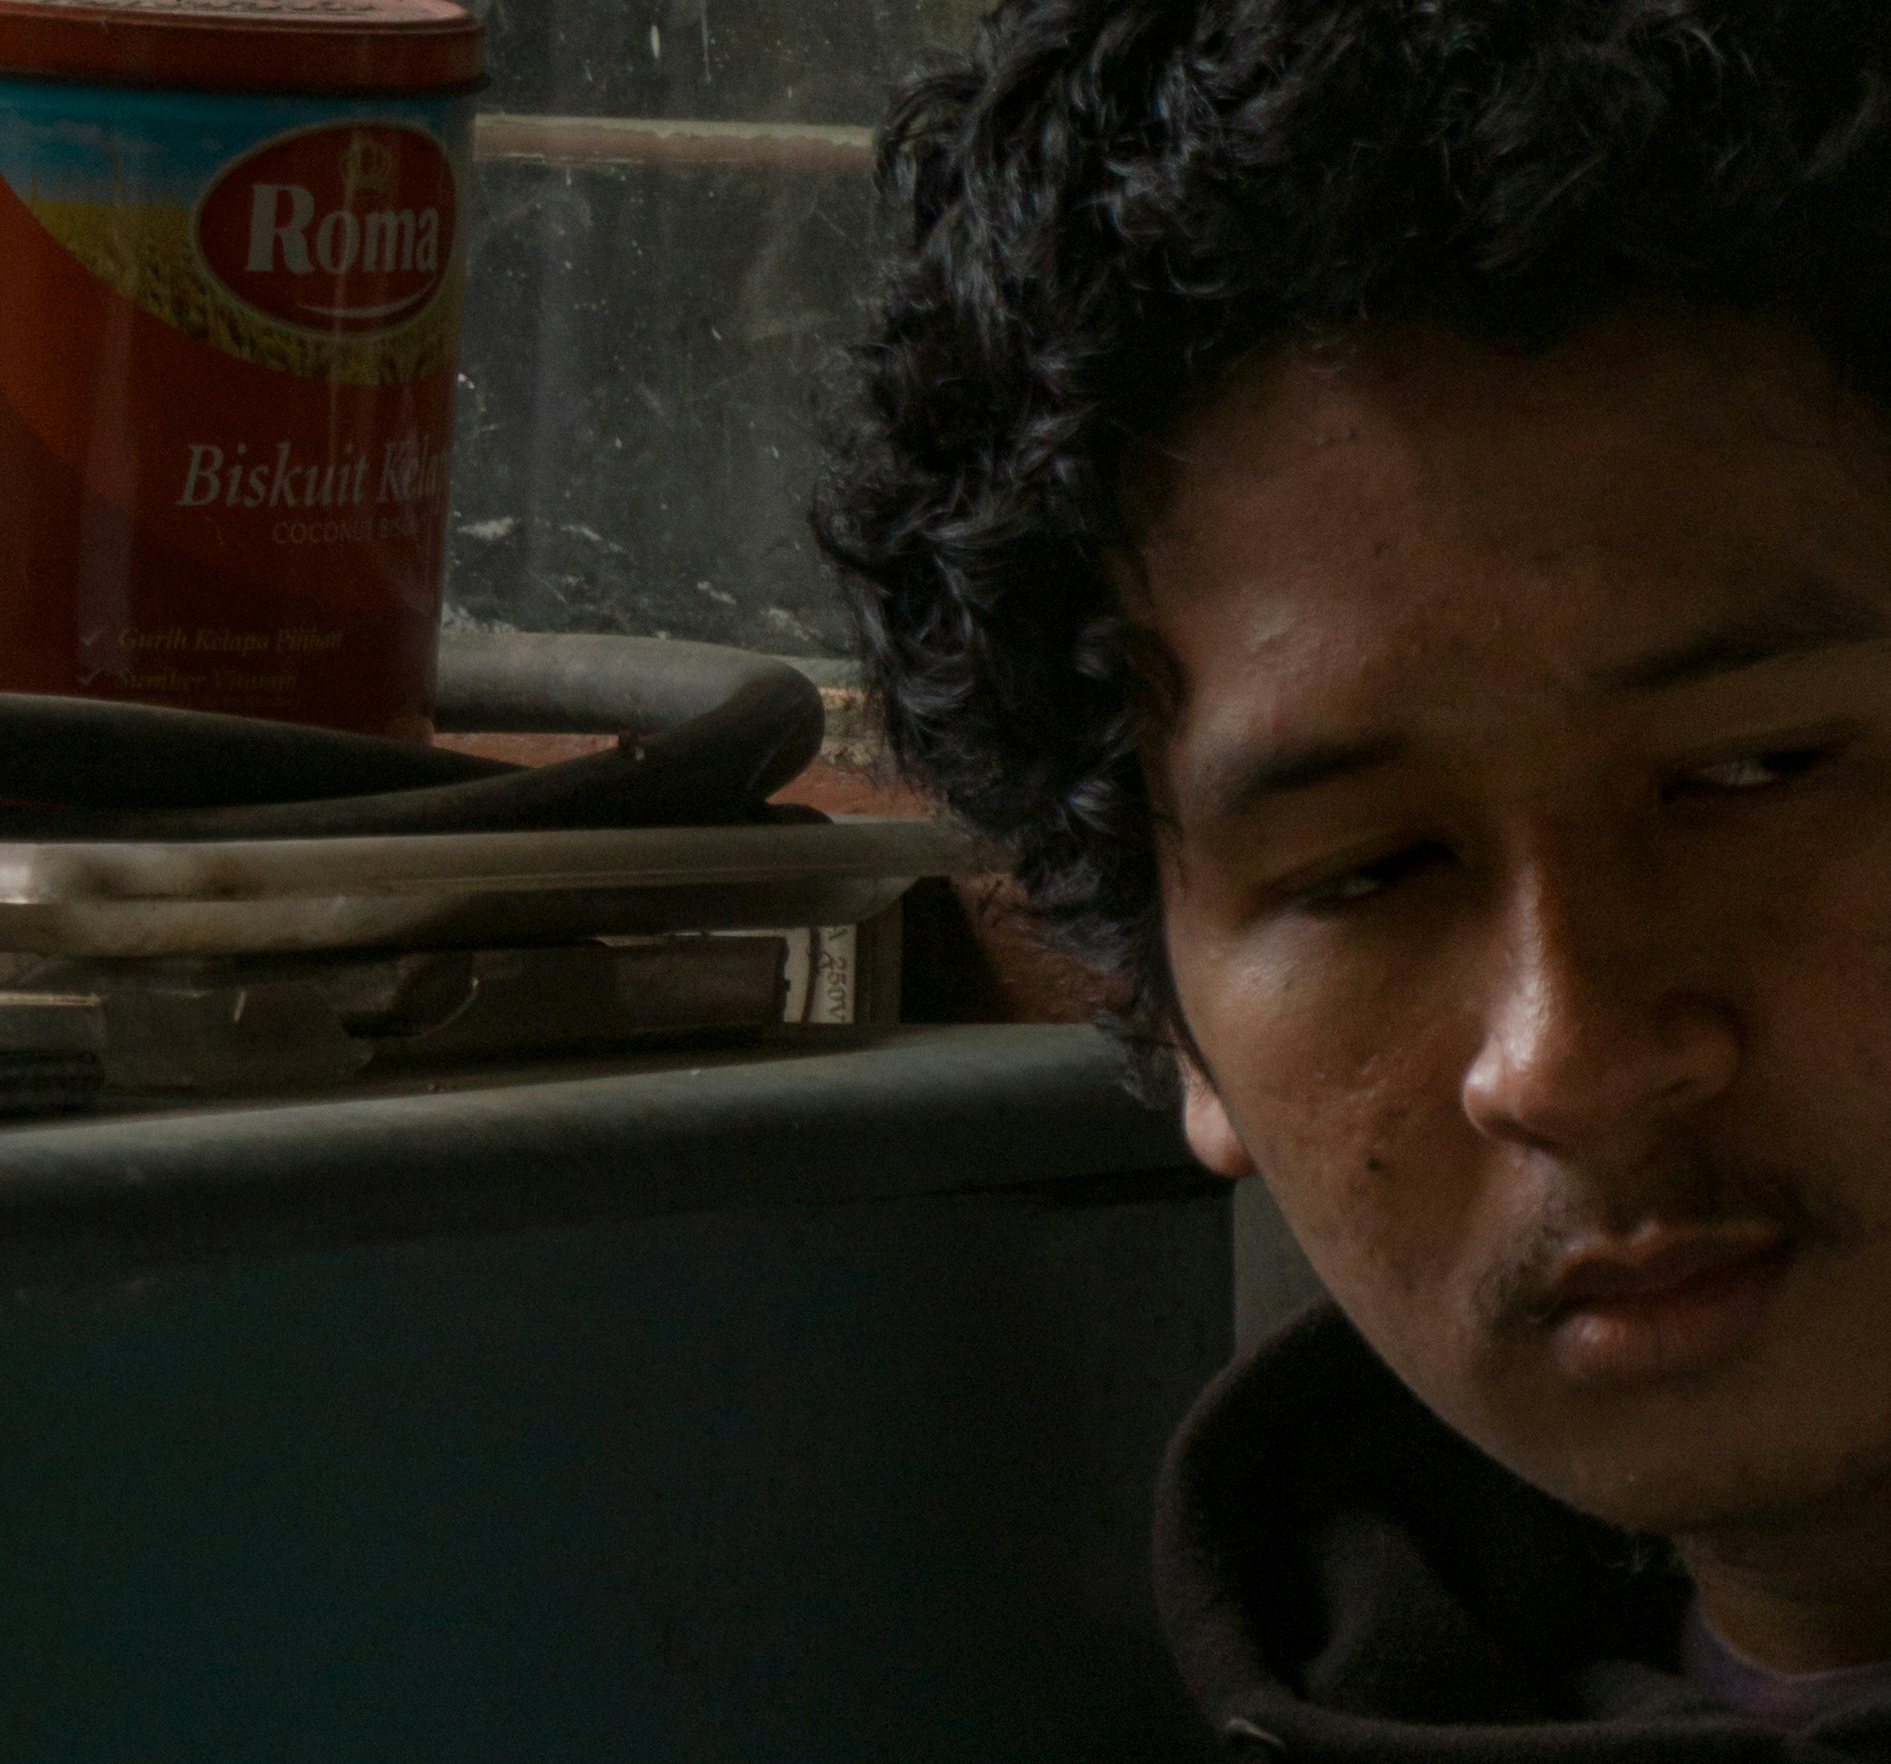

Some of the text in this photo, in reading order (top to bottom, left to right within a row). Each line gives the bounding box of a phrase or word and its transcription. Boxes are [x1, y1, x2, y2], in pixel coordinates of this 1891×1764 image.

[243, 182, 440, 276] Roma
[175, 439, 369, 509] Biskuit
[271, 518, 373, 546] COCONUT
